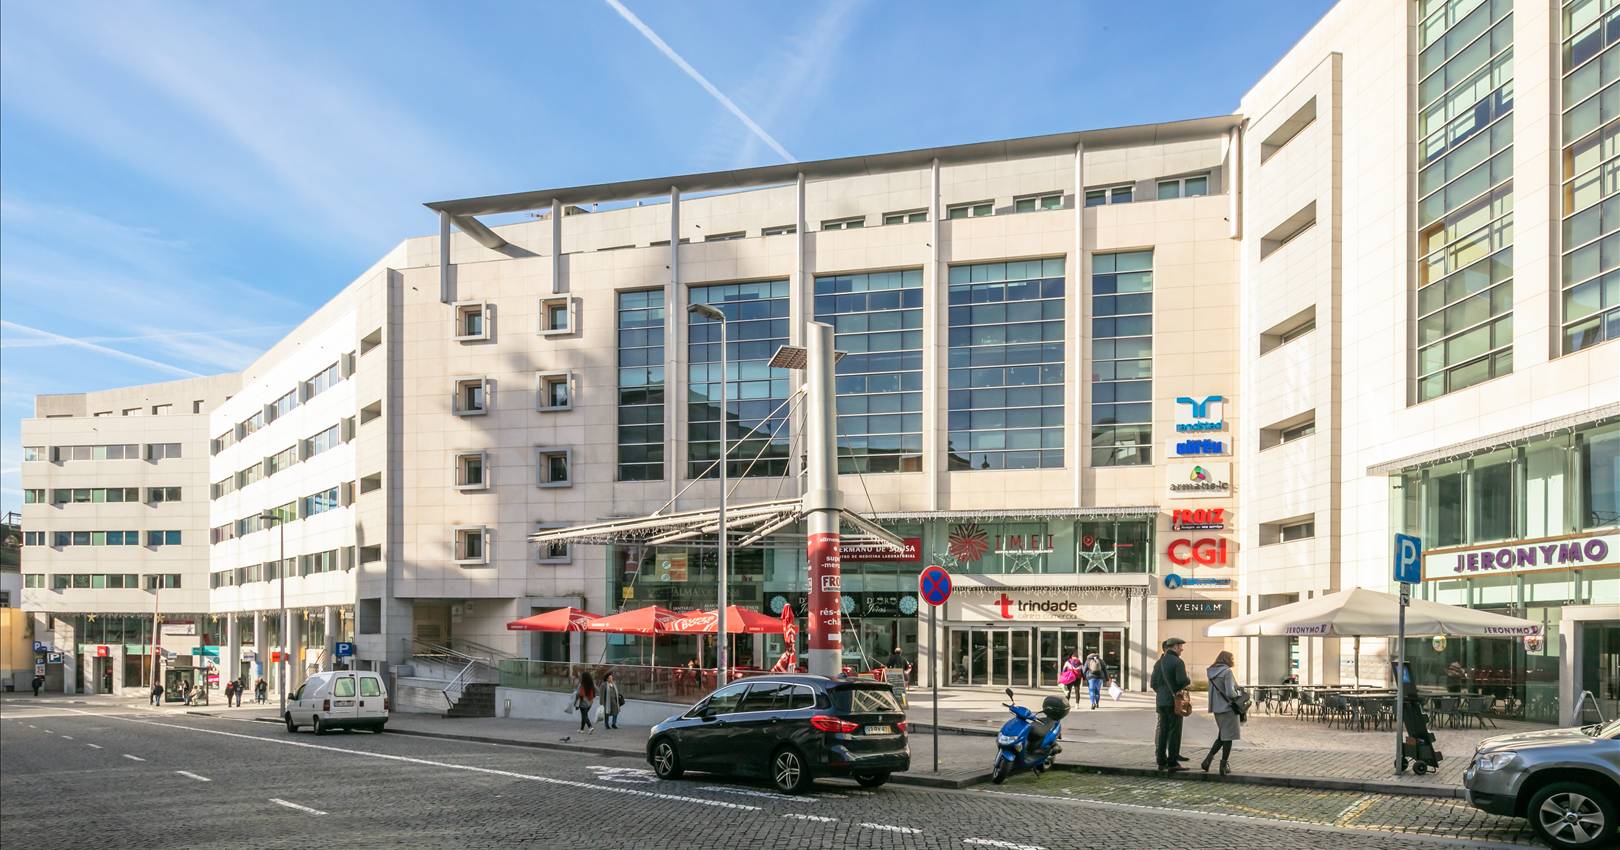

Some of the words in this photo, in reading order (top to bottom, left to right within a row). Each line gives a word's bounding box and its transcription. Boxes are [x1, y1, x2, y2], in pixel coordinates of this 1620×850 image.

[1168, 538, 1226, 565] CGI
[1401, 539, 1416, 577] P
[1454, 539, 1608, 573] JERONYMO
[1018, 600, 1077, 612] trindade
[339, 643, 350, 653] P
